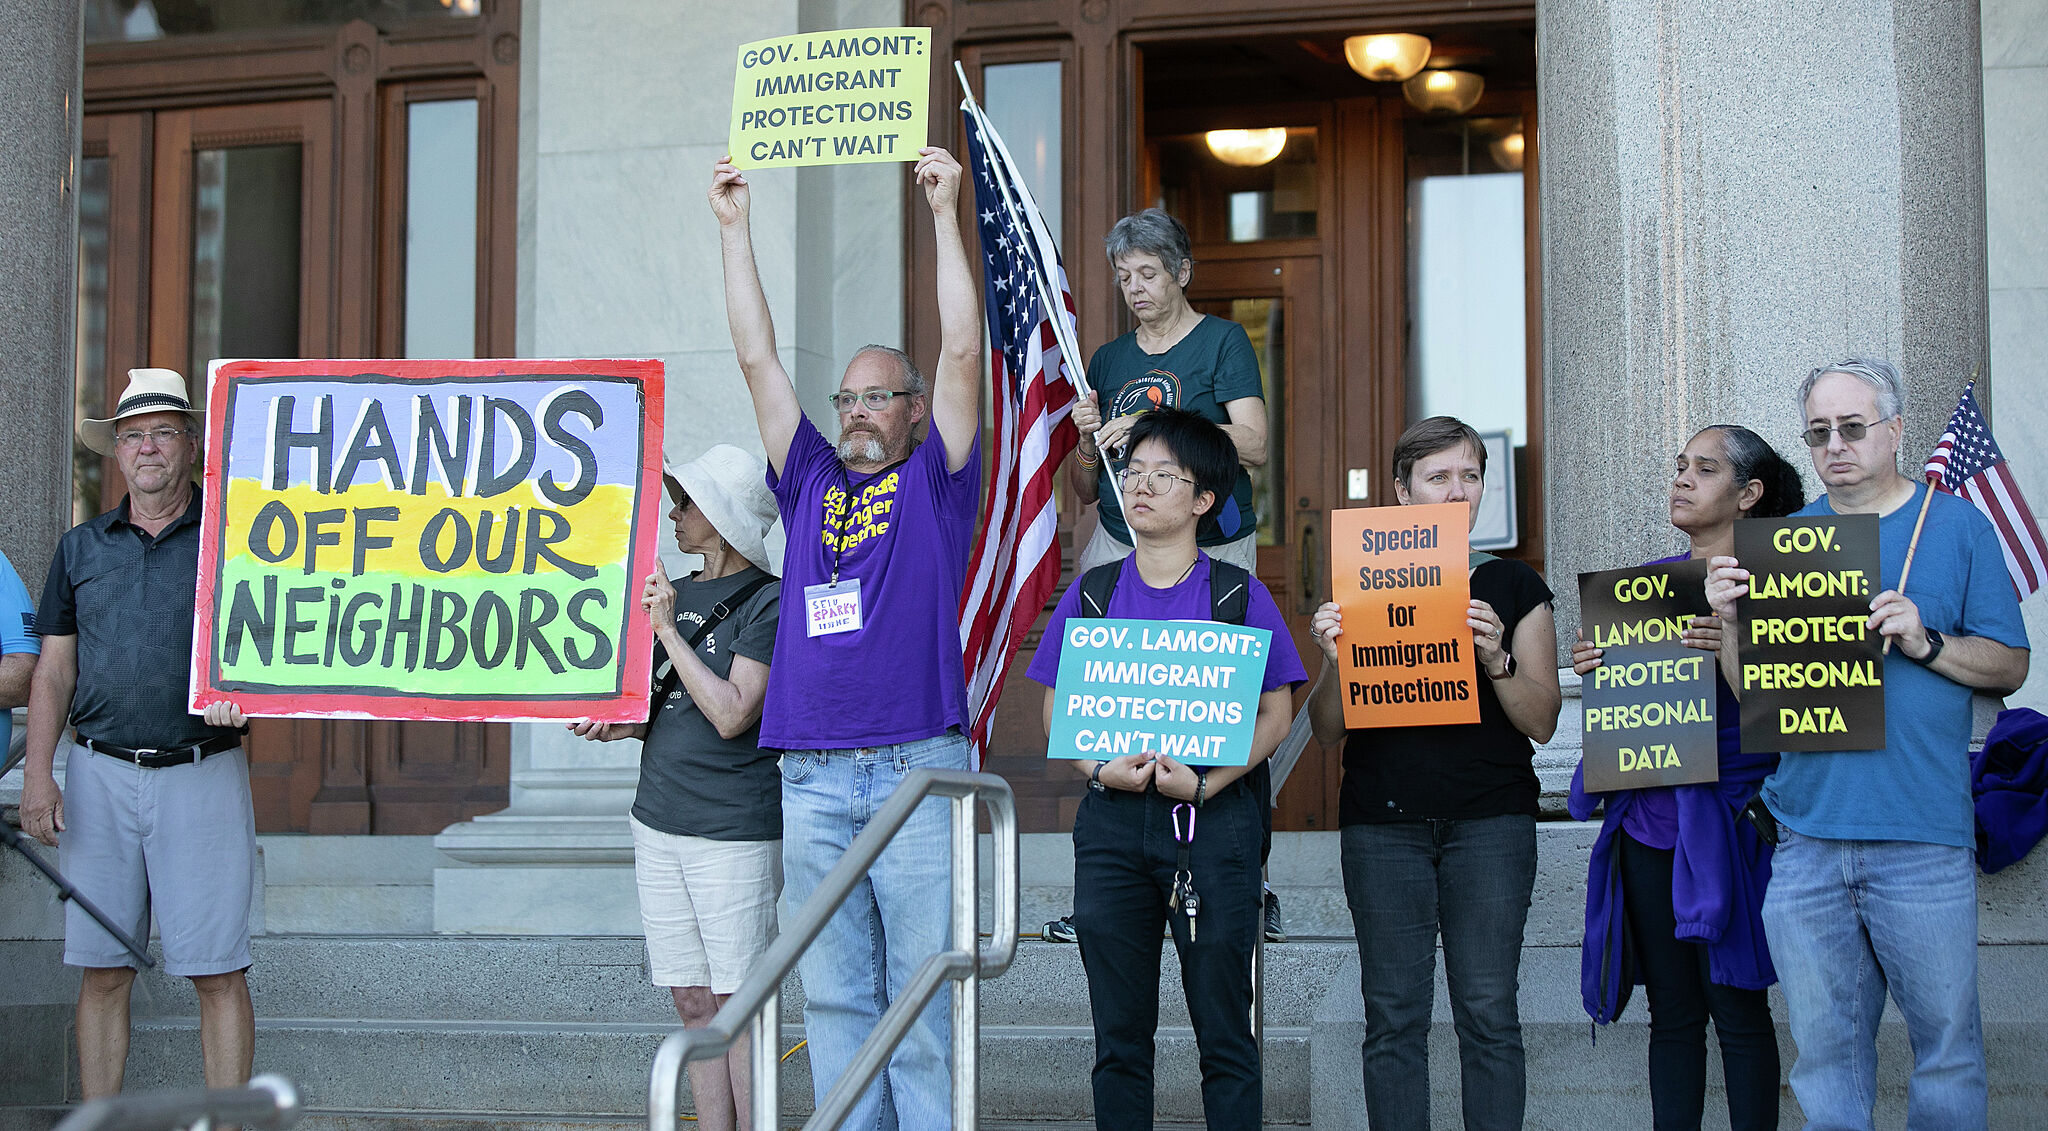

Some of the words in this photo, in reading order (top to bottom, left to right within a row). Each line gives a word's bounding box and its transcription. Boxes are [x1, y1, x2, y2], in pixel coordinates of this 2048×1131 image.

[743, 43, 799, 69] GOV.
[807, 35, 923, 60] LAMONT:
[755, 68, 902, 98] IMMIGRANT
[741, 100, 912, 131] PROTECTIONS
[750, 136, 827, 161] CAN'T
[833, 134, 899, 157] WAIT
[264, 388, 604, 507] HANDS
[248, 500, 402, 577] OFF
[418, 505, 599, 580] OUR
[1362, 524, 1438, 556] Special
[1773, 526, 1841, 554] GOV.
[1359, 562, 1442, 591] Session
[1614, 573, 1675, 603] GOV.
[1749, 570, 1869, 600] LAMONT:
[813, 602, 857, 621] SPARKY
[1387, 603, 1417, 628] for
[1069, 625, 1134, 650] GOV.
[1141, 627, 1263, 658] LAMONT:
[1751, 615, 1869, 645] PROTECT
[1351, 637, 1460, 668] Immigrant
[1083, 660, 1236, 689] IMMIGRANT
[1594, 656, 1704, 690] PROTECT
[1743, 660, 1882, 690] PERSONAL
[1349, 677, 1470, 706] Protections
[1067, 694, 1243, 725] PROTECTIONS
[1585, 698, 1713, 732] PERSONAL
[1779, 706, 1848, 734] DATA
[1075, 729, 1155, 754] CAN'T
[1160, 733, 1227, 759] WAIT
[1618, 743, 1682, 772] DATA
